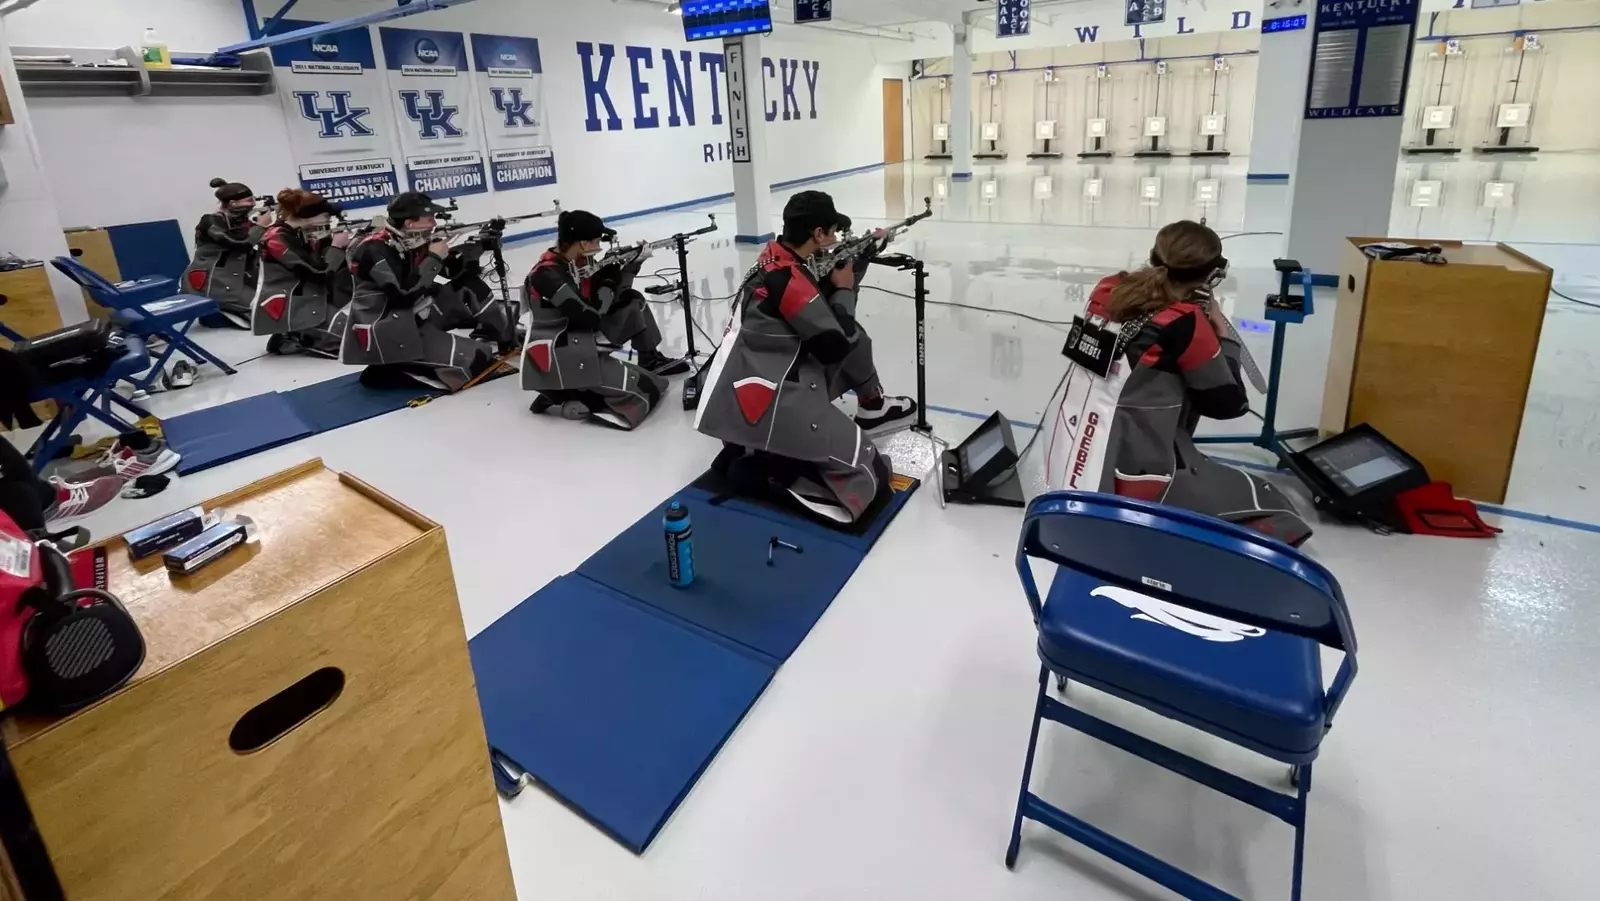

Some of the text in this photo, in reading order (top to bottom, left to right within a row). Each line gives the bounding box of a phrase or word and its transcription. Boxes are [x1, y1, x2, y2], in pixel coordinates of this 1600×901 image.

[312, 43, 339, 53] NCAA
[417, 49, 439, 58] NCAA
[576, 41, 819, 131] KENTCKY
[293, 91, 374, 138] UK
[399, 90, 463, 139] UK
[490, 87, 536, 128] UK
[730, 52, 746, 157] FINISH
[308, 167, 345, 175] UNIVERSITY
[355, 163, 385, 171] KENTUCKY
[413, 158, 442, 166] UNIVERSITY
[496, 165, 553, 183] CHAMPION
[414, 172, 482, 193] CHAMPION
[1069, 411, 1099, 489] GOEBEL
